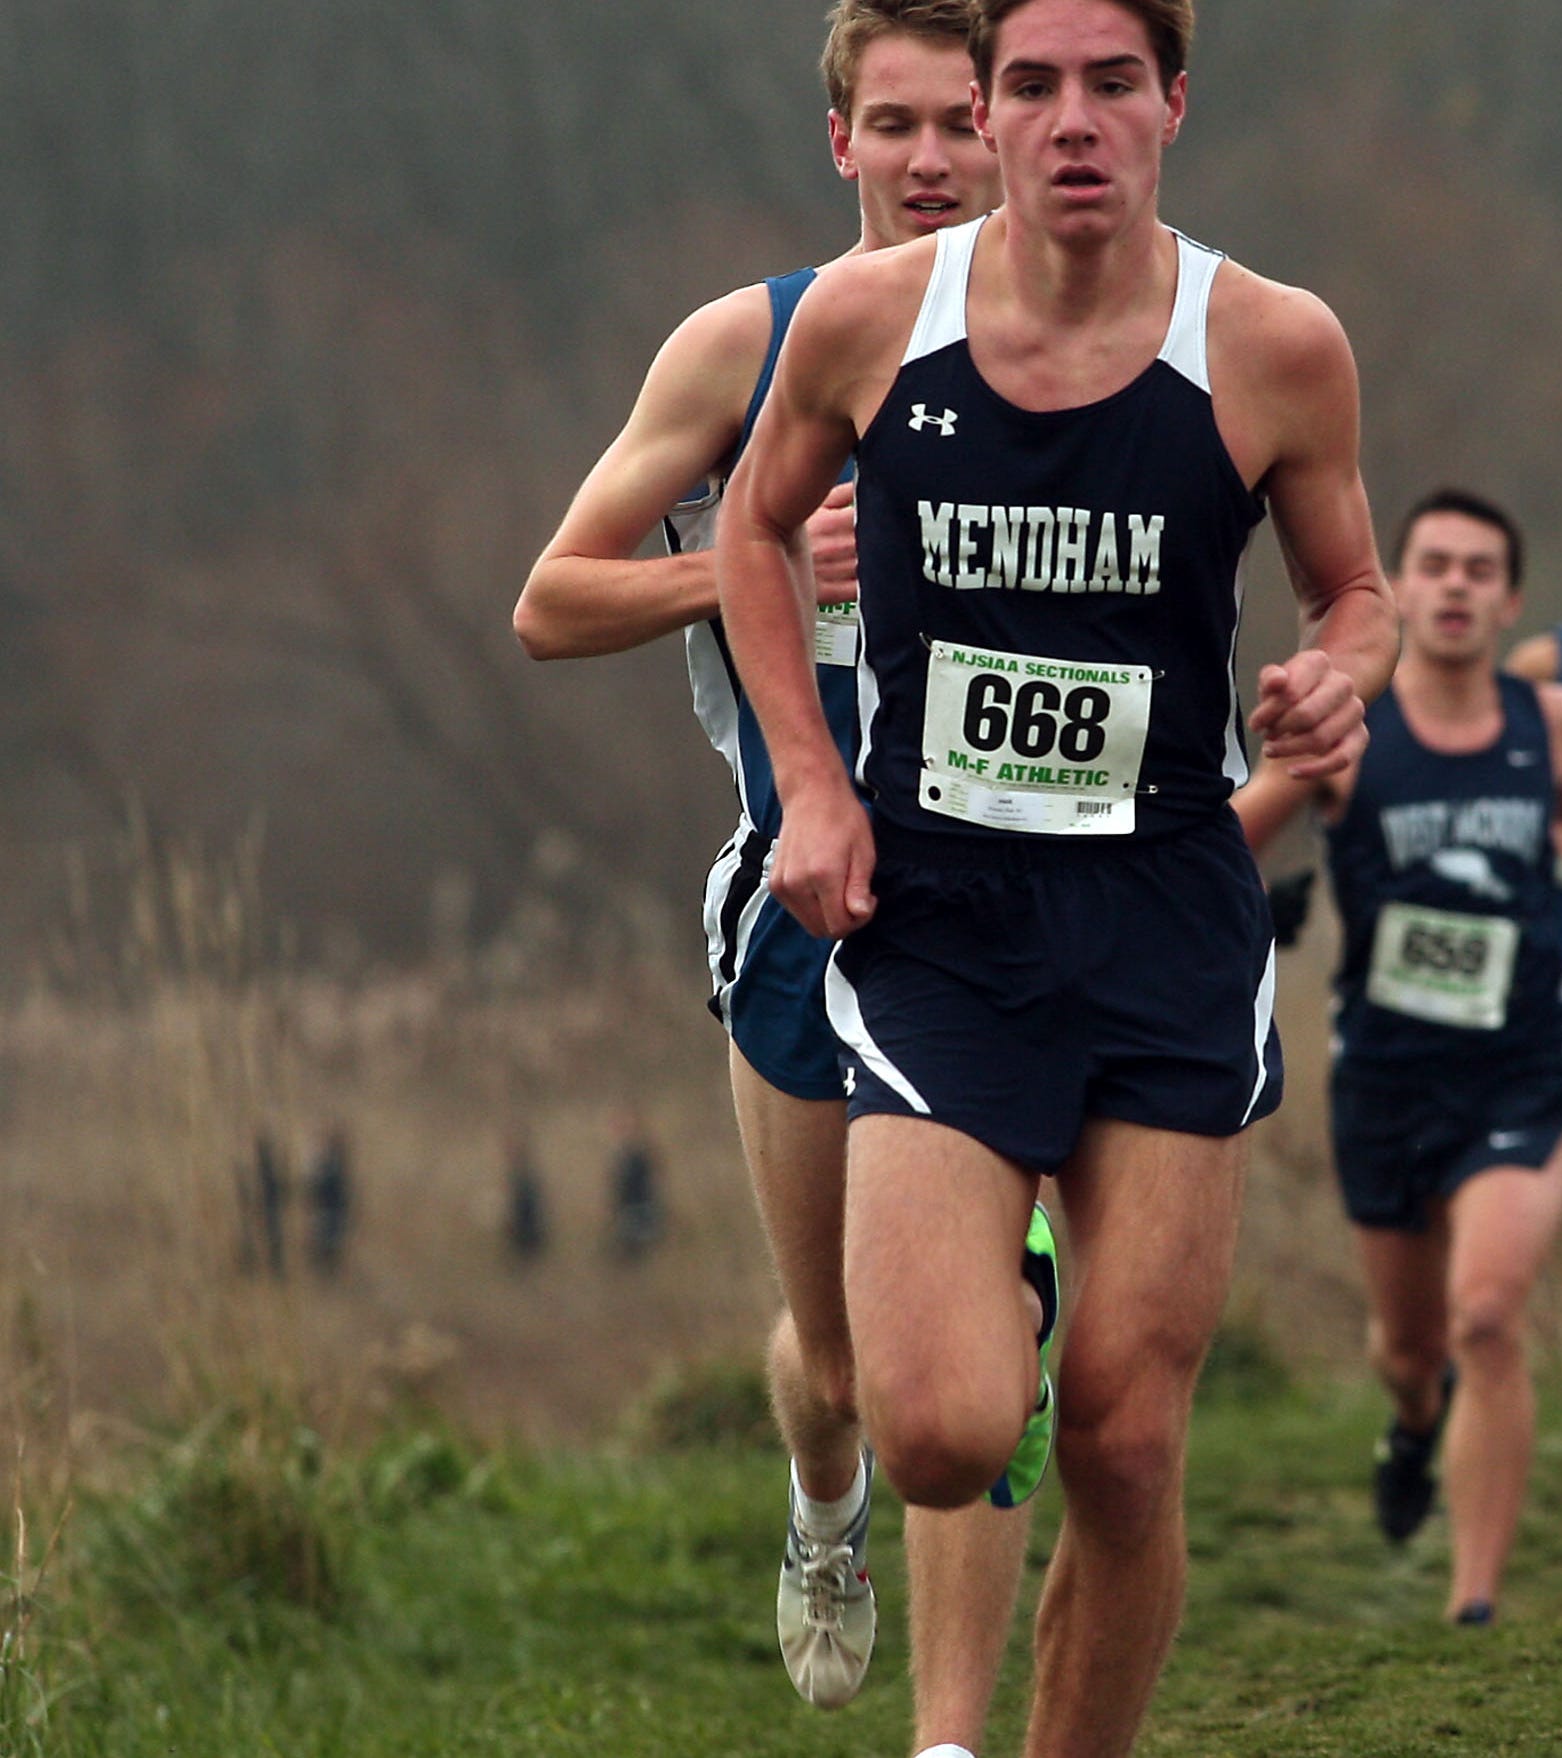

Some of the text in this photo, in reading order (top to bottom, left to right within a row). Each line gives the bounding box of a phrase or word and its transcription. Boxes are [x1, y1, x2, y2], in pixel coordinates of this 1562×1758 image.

[918, 500, 1165, 595] MENDHAM
[952, 651, 1131, 685] NJSIAA SECTIONALS
[963, 673, 1111, 763] 668
[948, 750, 990, 776] M-F
[997, 762, 1110, 787] ATHLETIC
[1402, 922, 1489, 977] 659
